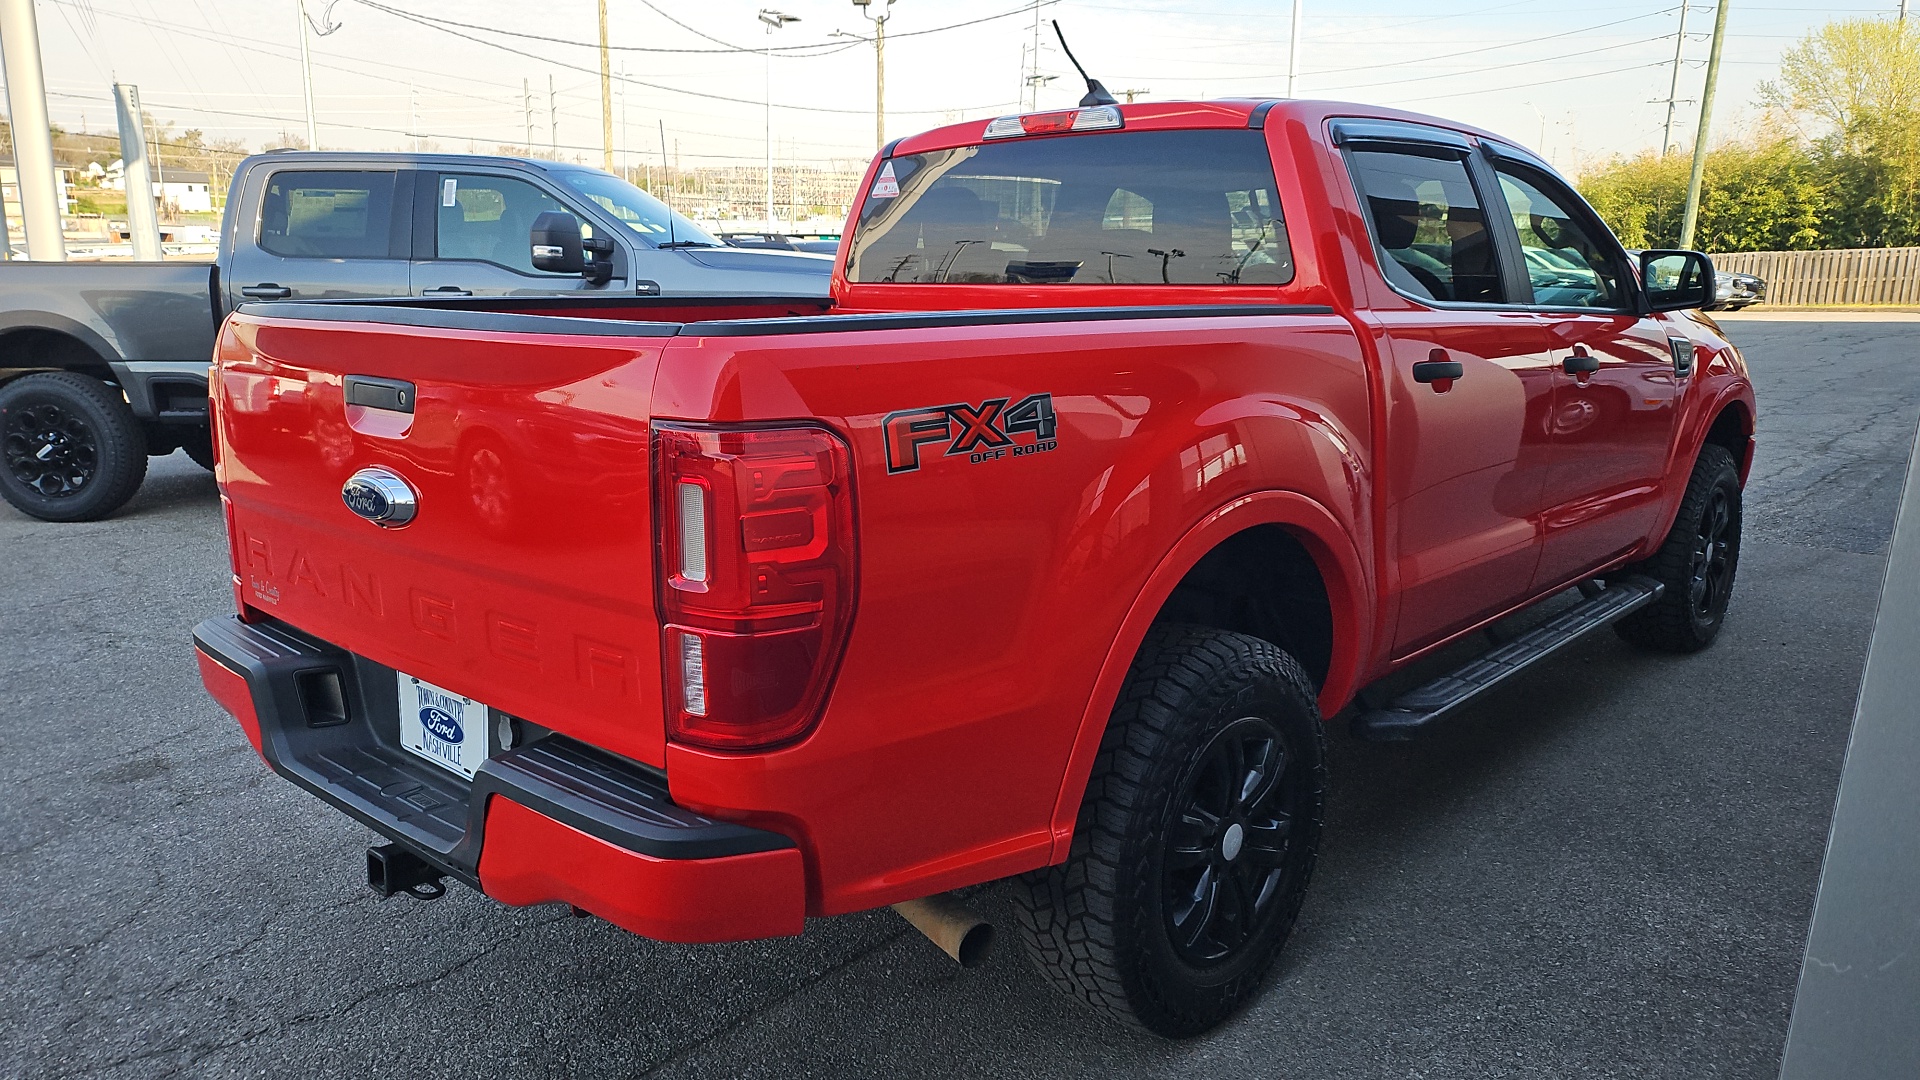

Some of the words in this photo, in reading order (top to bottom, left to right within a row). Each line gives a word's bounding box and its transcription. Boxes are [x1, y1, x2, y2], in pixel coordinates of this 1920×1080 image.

[881, 392, 1057, 475] FX4
[970, 449, 1006, 464] OFF
[1012, 440, 1058, 458] ROAD
[242, 528, 642, 704] RANGER
[416, 685, 435, 709] TOWN
[435, 692, 440, 707] &
[427, 709, 456, 740] Ford
[422, 727, 461, 766] NASHVILLE
